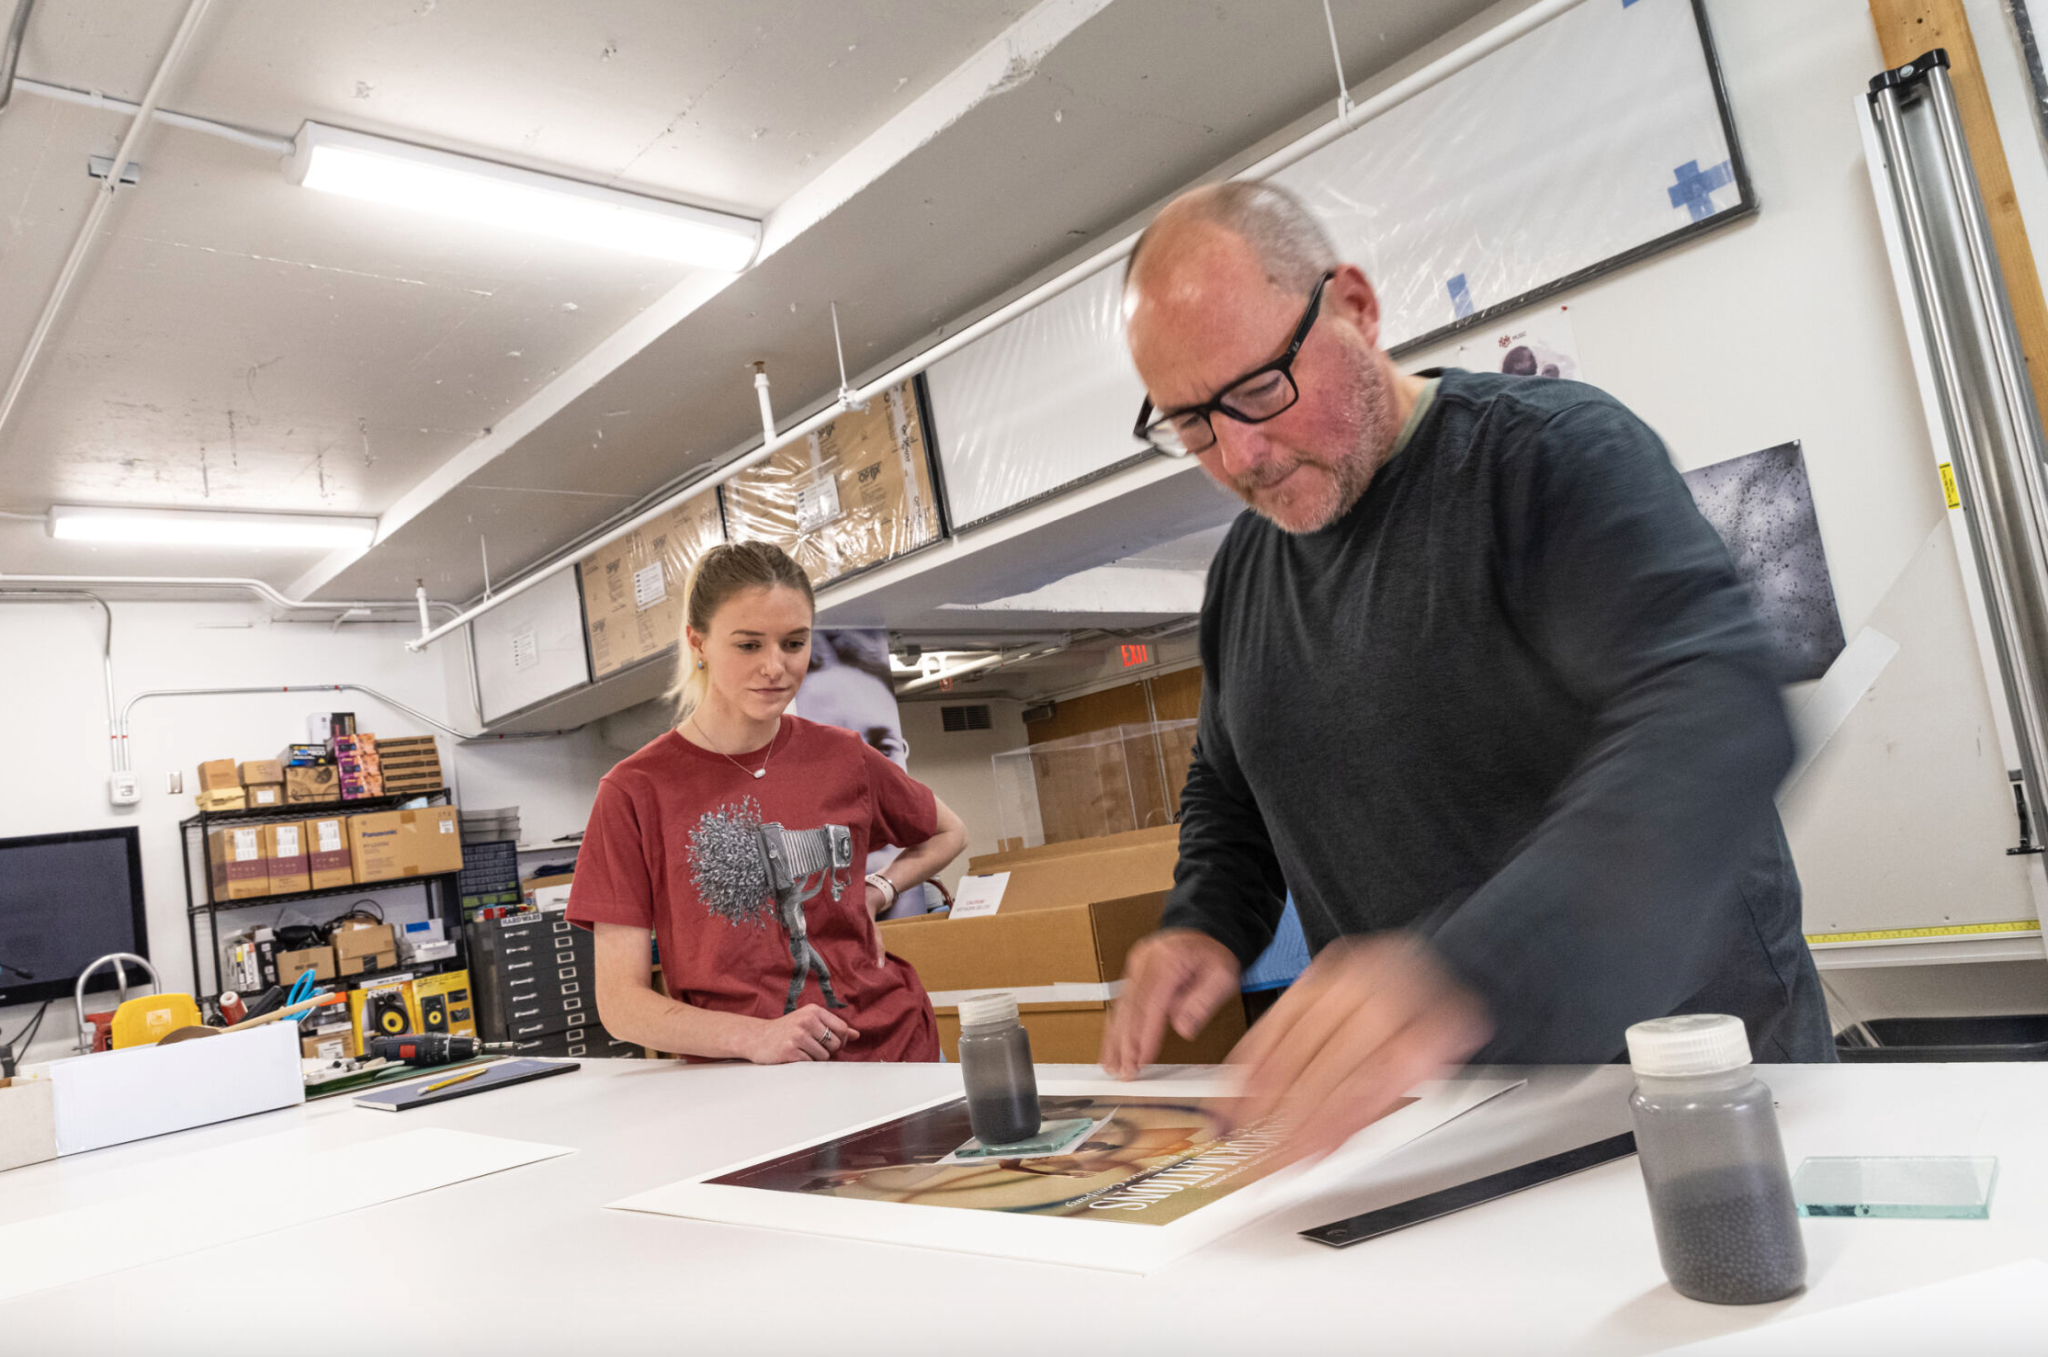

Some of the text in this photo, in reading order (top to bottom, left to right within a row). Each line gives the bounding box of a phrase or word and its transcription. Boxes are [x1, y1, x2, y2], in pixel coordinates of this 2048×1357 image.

[1120, 644, 1148, 668] EXIT
[362, 829, 398, 838] Panasonic
[1064, 1182, 1126, 1209] Company
